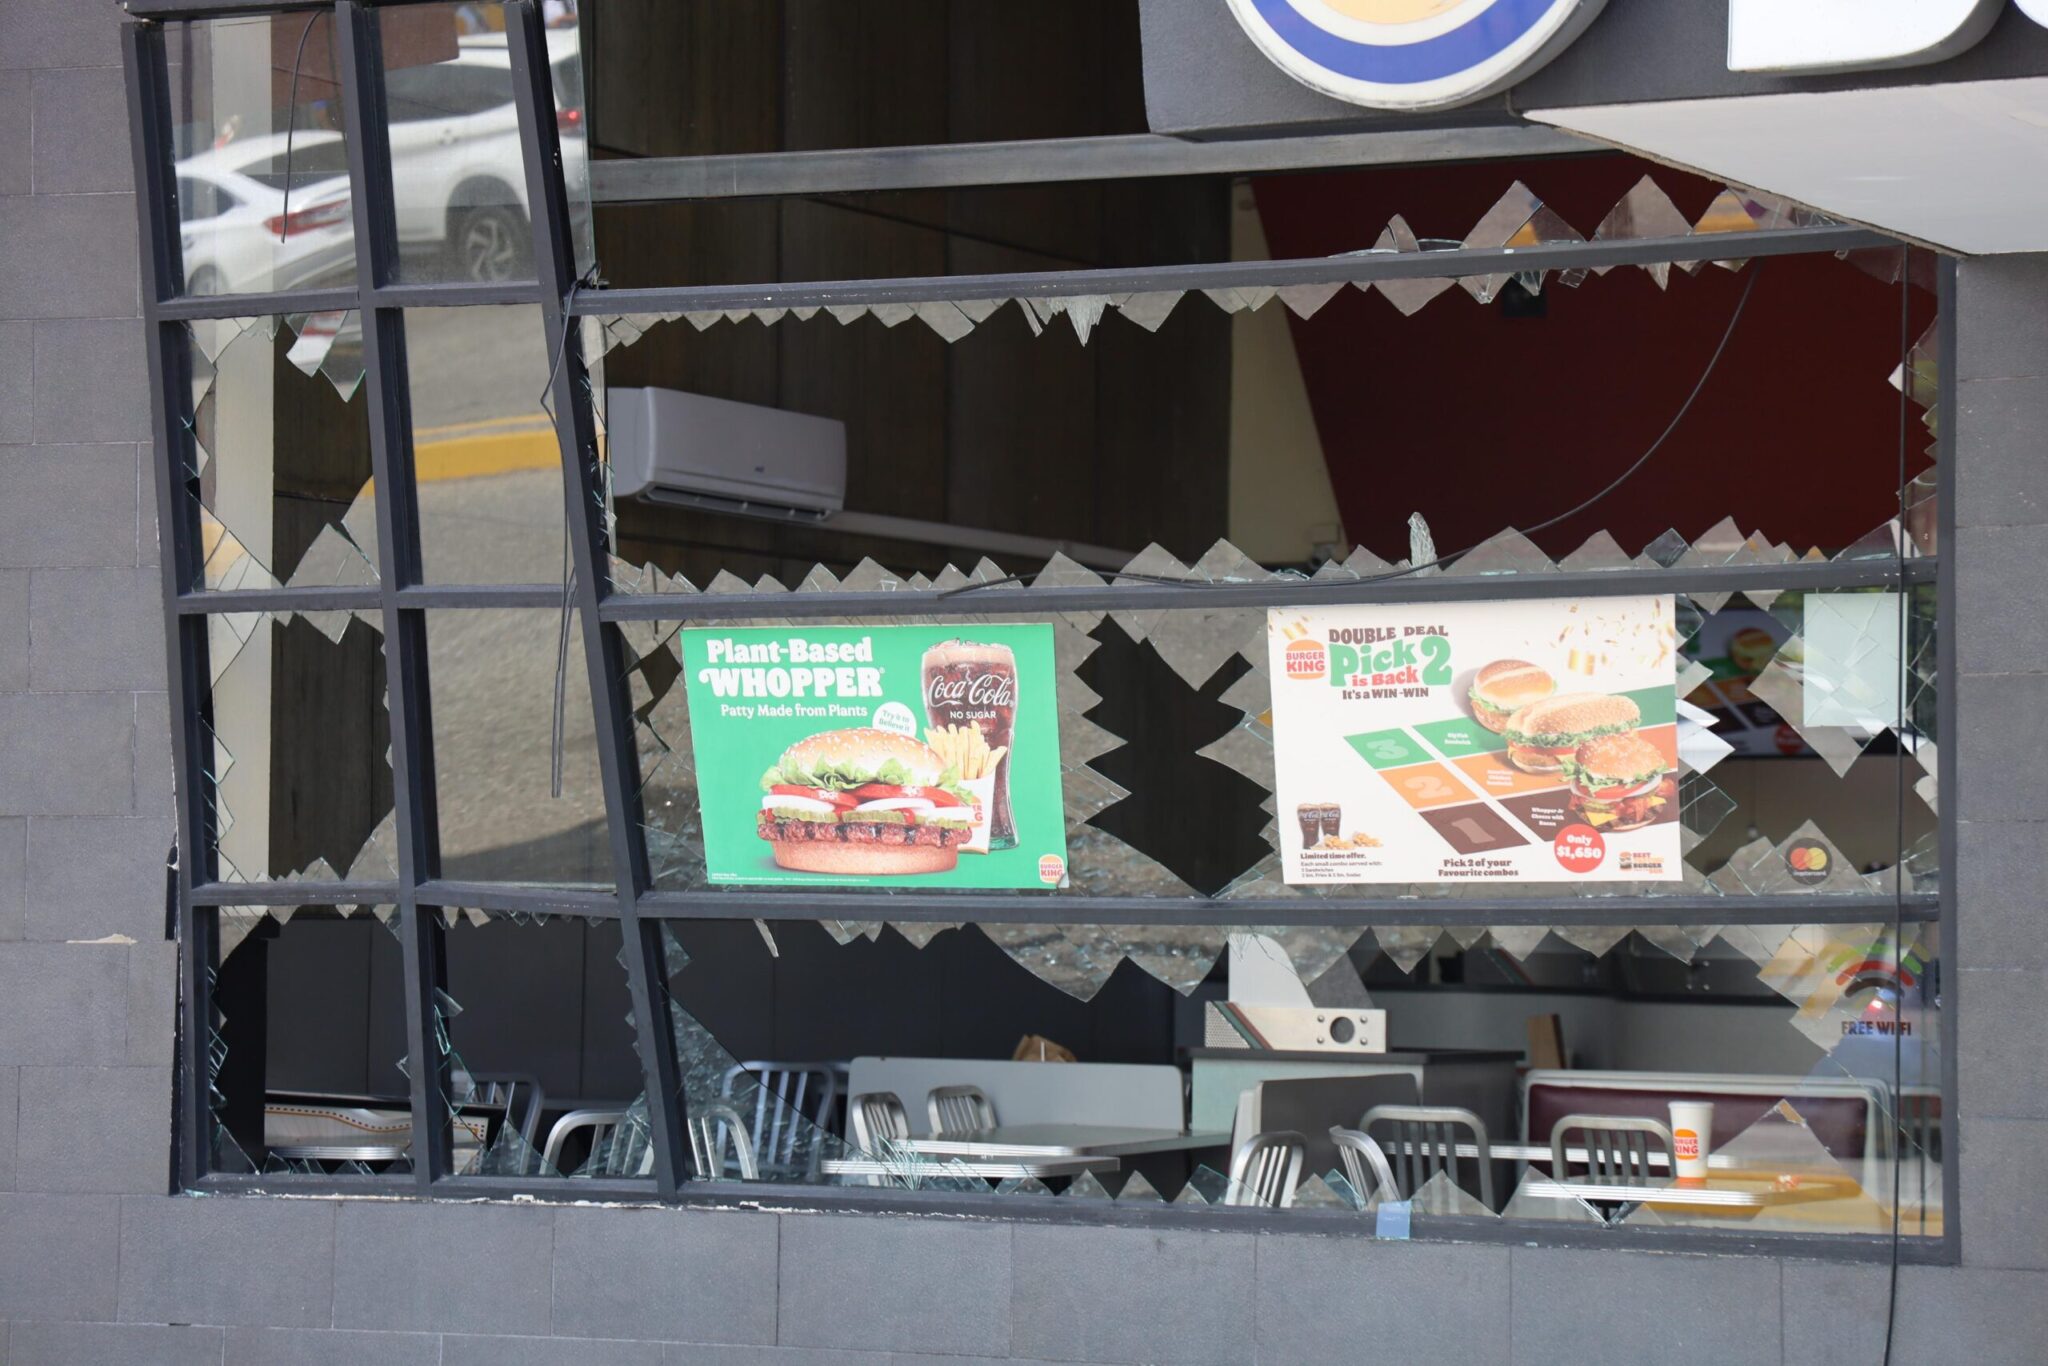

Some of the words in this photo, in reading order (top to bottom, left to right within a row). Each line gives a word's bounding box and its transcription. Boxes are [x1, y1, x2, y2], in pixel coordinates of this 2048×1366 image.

[1329, 627, 1396, 645] DOUBLE
[1404, 625, 1449, 637] DEAL
[706, 636, 873, 663] Plant-Based
[1286, 651, 1325, 660] BURGER
[1286, 660, 1325, 672] KING
[1329, 639, 1417, 687] Pick
[1420, 635, 1453, 686] 2
[698, 667, 883, 698] WHOPPER
[1352, 674, 1368, 687] is
[1372, 665, 1419, 686] Back
[929, 674, 1013, 707] Coca-Cola
[1342, 689, 1361, 700] It's
[1363, 691, 1370, 699] a
[721, 703, 754, 719] Patty
[758, 704, 793, 717] Made
[795, 703, 826, 717] from
[828, 703, 868, 717] Plants
[949, 711, 963, 719] NO
[966, 710, 996, 719] SUGAR
[1366, 738, 1409, 760] 3
[1404, 775, 1454, 799] 2
[1451, 817, 1496, 844] 1
[1566, 834, 1593, 846] Only
[1556, 845, 1603, 860] $1,650
[1443, 858, 1466, 867] Pick
[1467, 859, 1474, 867] 2
[1475, 858, 1486, 867] of
[1487, 859, 1512, 868] your
[1040, 869, 1063, 877] KING
[1438, 868, 1482, 877] Favourite
[1483, 868, 1519, 877] combos
[1841, 1021, 1873, 1035] FREE
